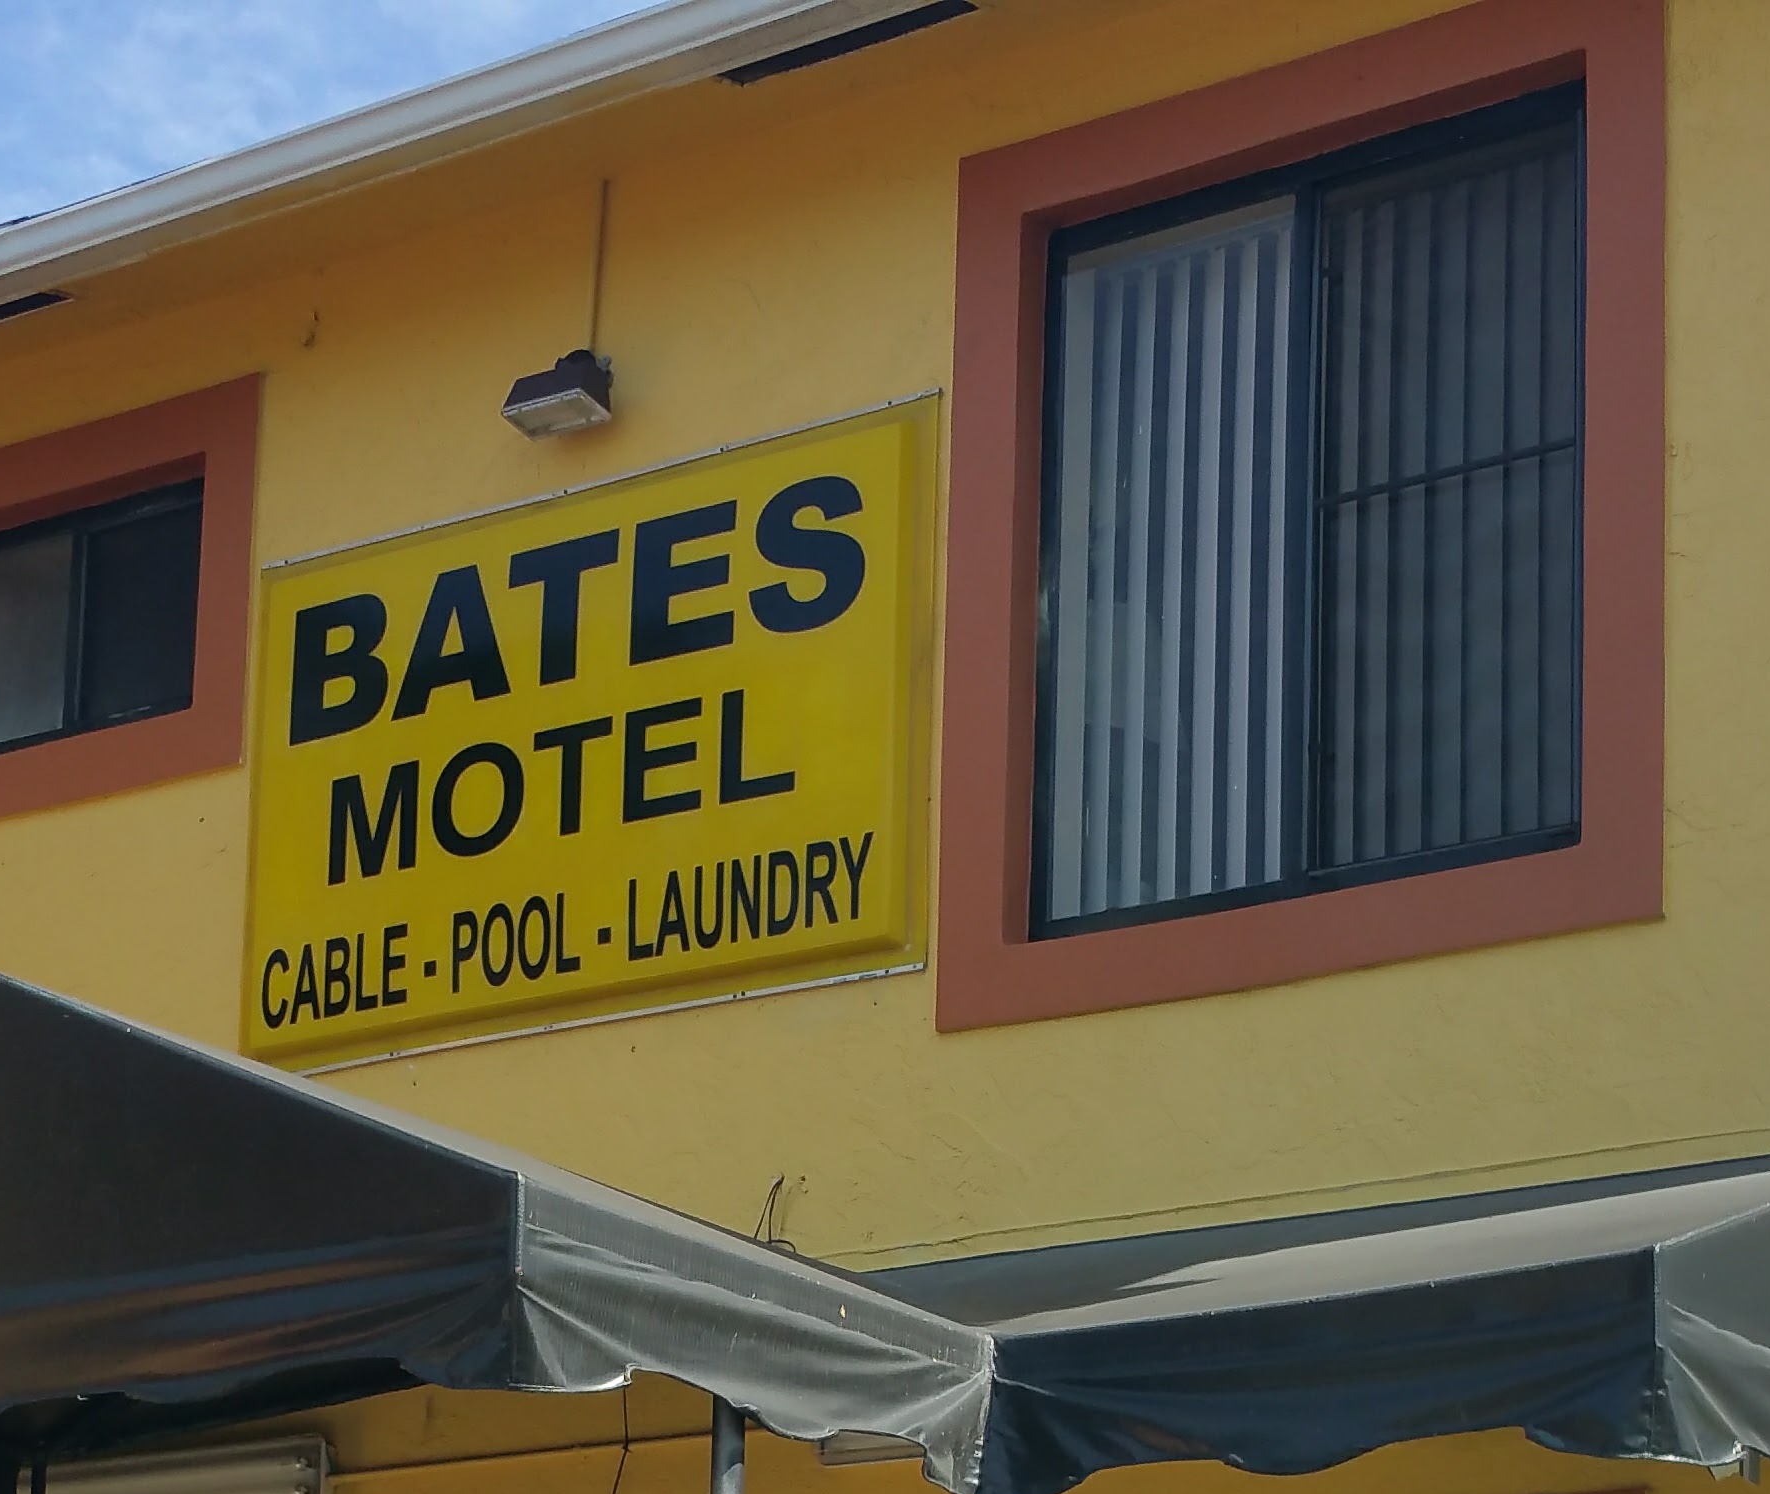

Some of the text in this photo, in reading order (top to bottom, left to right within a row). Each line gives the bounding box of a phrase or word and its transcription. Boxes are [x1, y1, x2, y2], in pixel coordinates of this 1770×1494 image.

[290, 475, 866, 746] BATES
[327, 689, 796, 886] MOTEL
[262, 923, 408, 1029] CABLE
[451, 892, 581, 993] POOL
[628, 832, 874, 960] LAUNDRY
